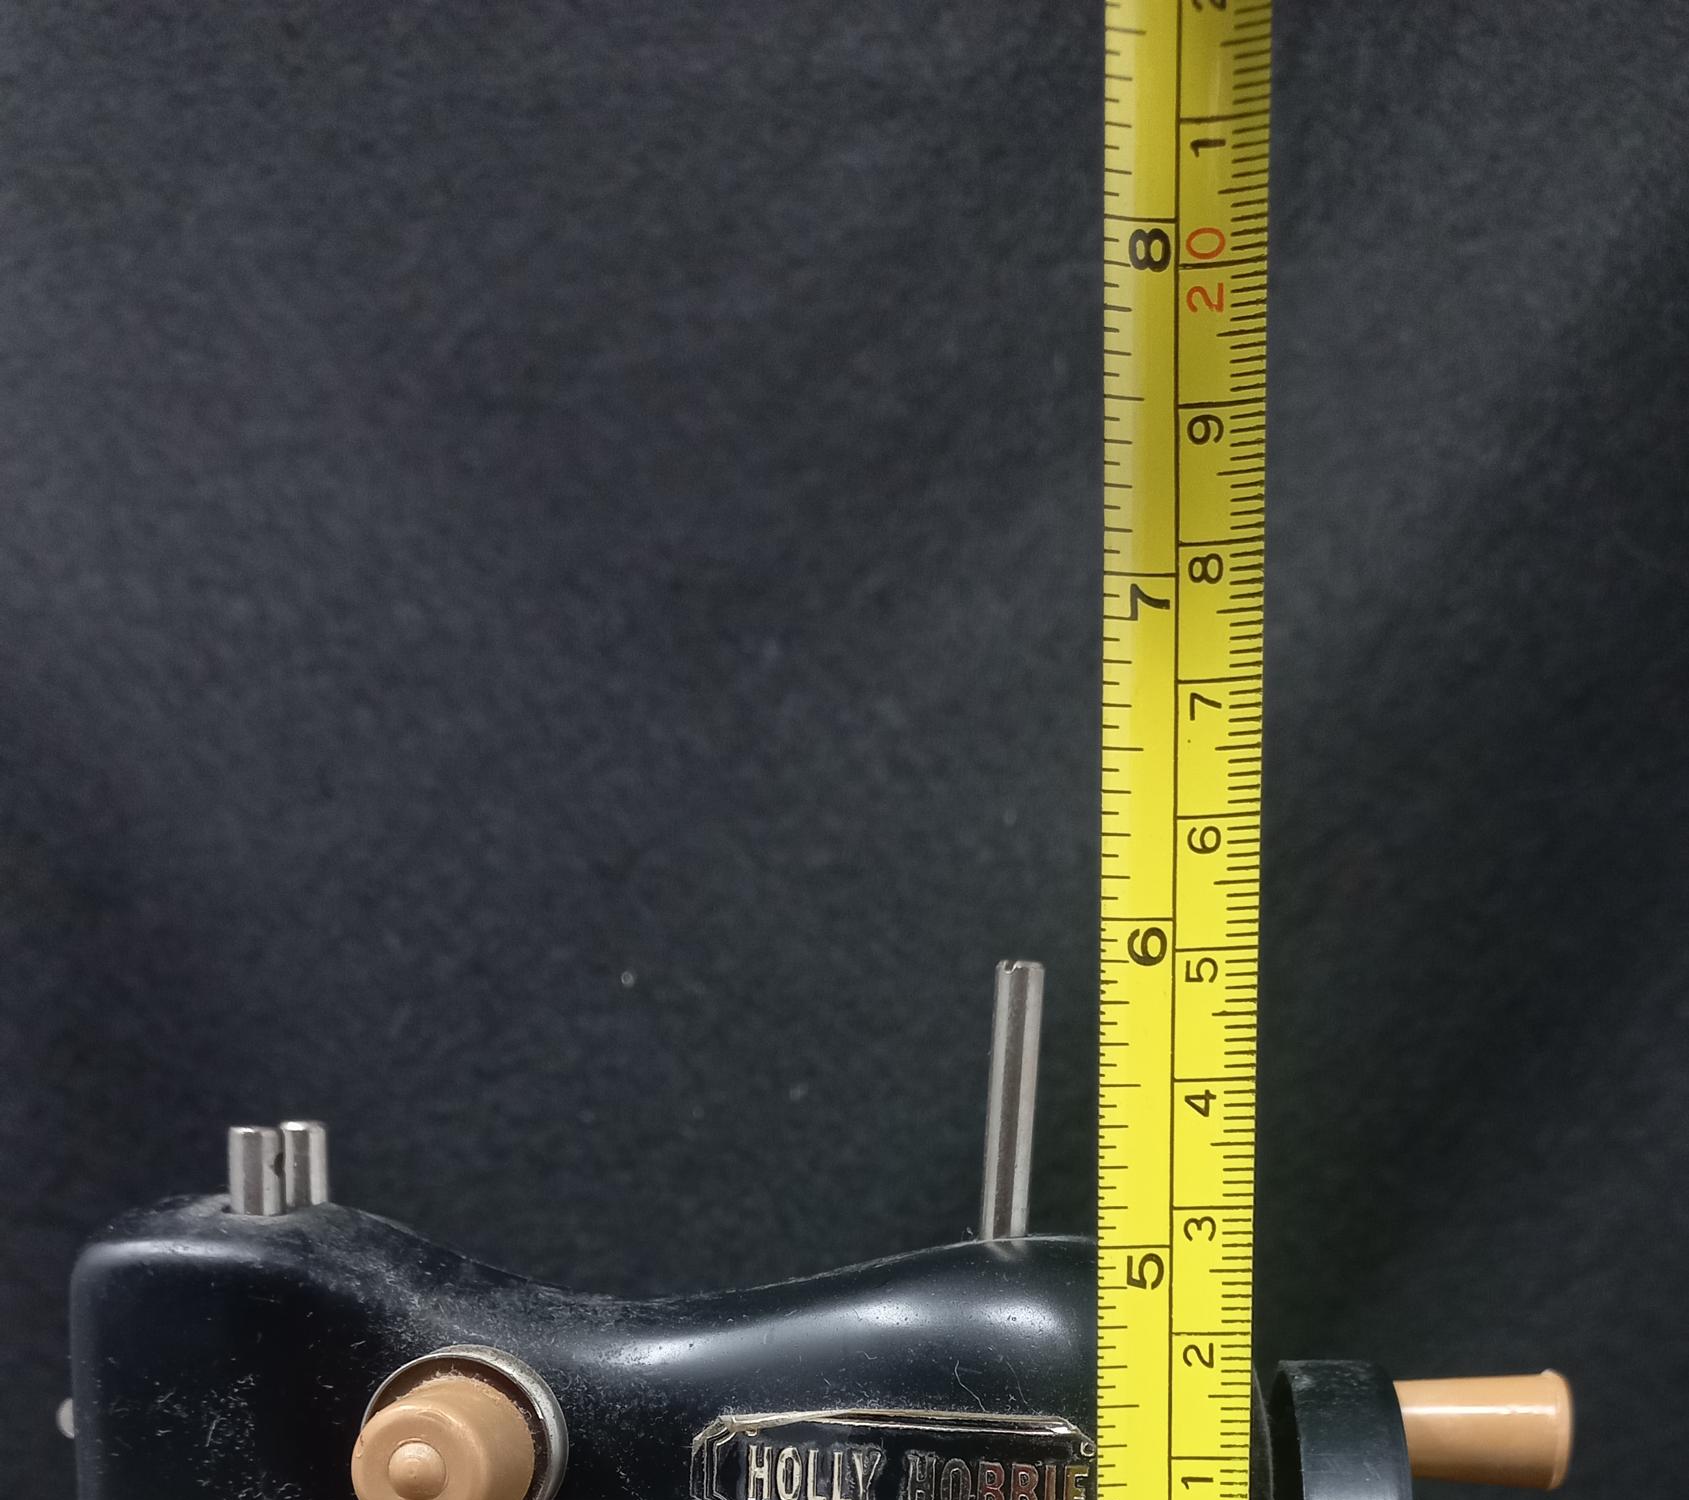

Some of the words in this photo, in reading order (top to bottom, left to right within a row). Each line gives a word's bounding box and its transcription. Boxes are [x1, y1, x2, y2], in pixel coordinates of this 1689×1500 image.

[1190, 138, 1227, 158] 1
[1129, 228, 1171, 272] 8
[1187, 413, 1224, 445] 9
[1188, 553, 1223, 584] 8
[1130, 583, 1170, 621] 7
[1190, 692, 1222, 721] 7
[1187, 825, 1221, 854] 6
[1127, 926, 1168, 966] 6
[1184, 957, 1218, 983] 5
[1184, 1089, 1217, 1117] 4
[1183, 1216, 1216, 1241] 3
[1126, 1252, 1164, 1290] 5
[1182, 1342, 1215, 1368] 2
[1181, 1476, 1214, 1490] 1
